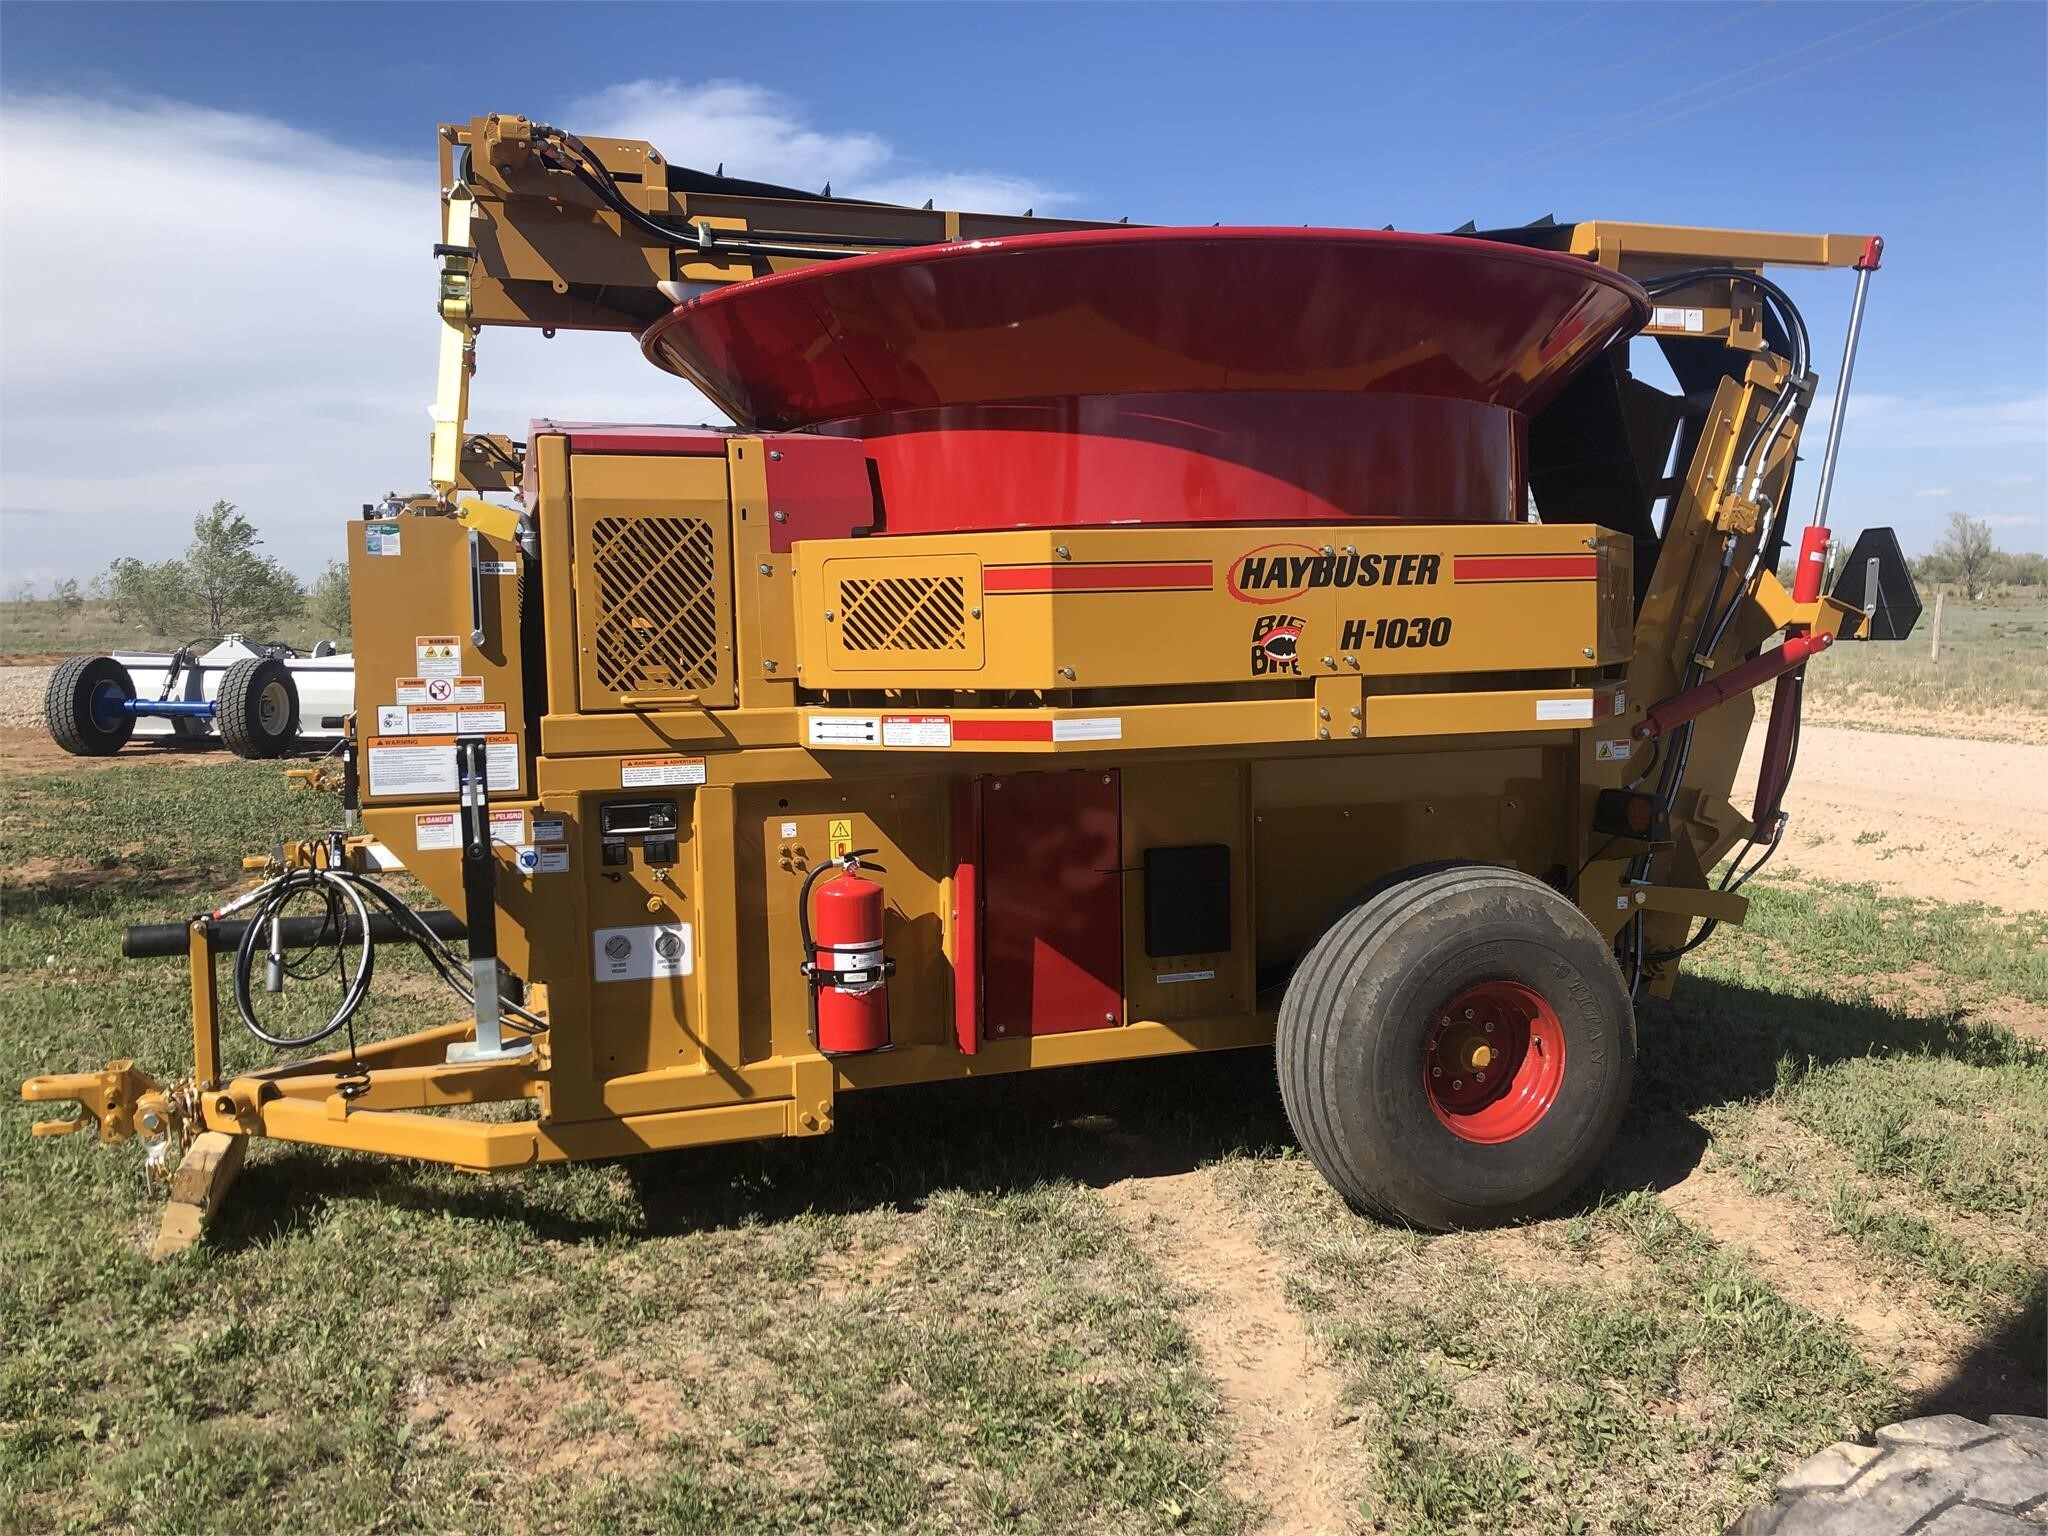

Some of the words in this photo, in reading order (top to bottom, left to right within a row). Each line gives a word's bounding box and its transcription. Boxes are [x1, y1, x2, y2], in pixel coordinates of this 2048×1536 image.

[1239, 554, 1440, 589] HAYBUSTER
[1252, 614, 1307, 643] BIG
[1339, 617, 1453, 651] H-1030
[1251, 645, 1302, 676] BITE
[426, 816, 453, 824] DANGER
[495, 812, 522, 820] PELIGRO
[1568, 978, 1608, 1065] TITAN
